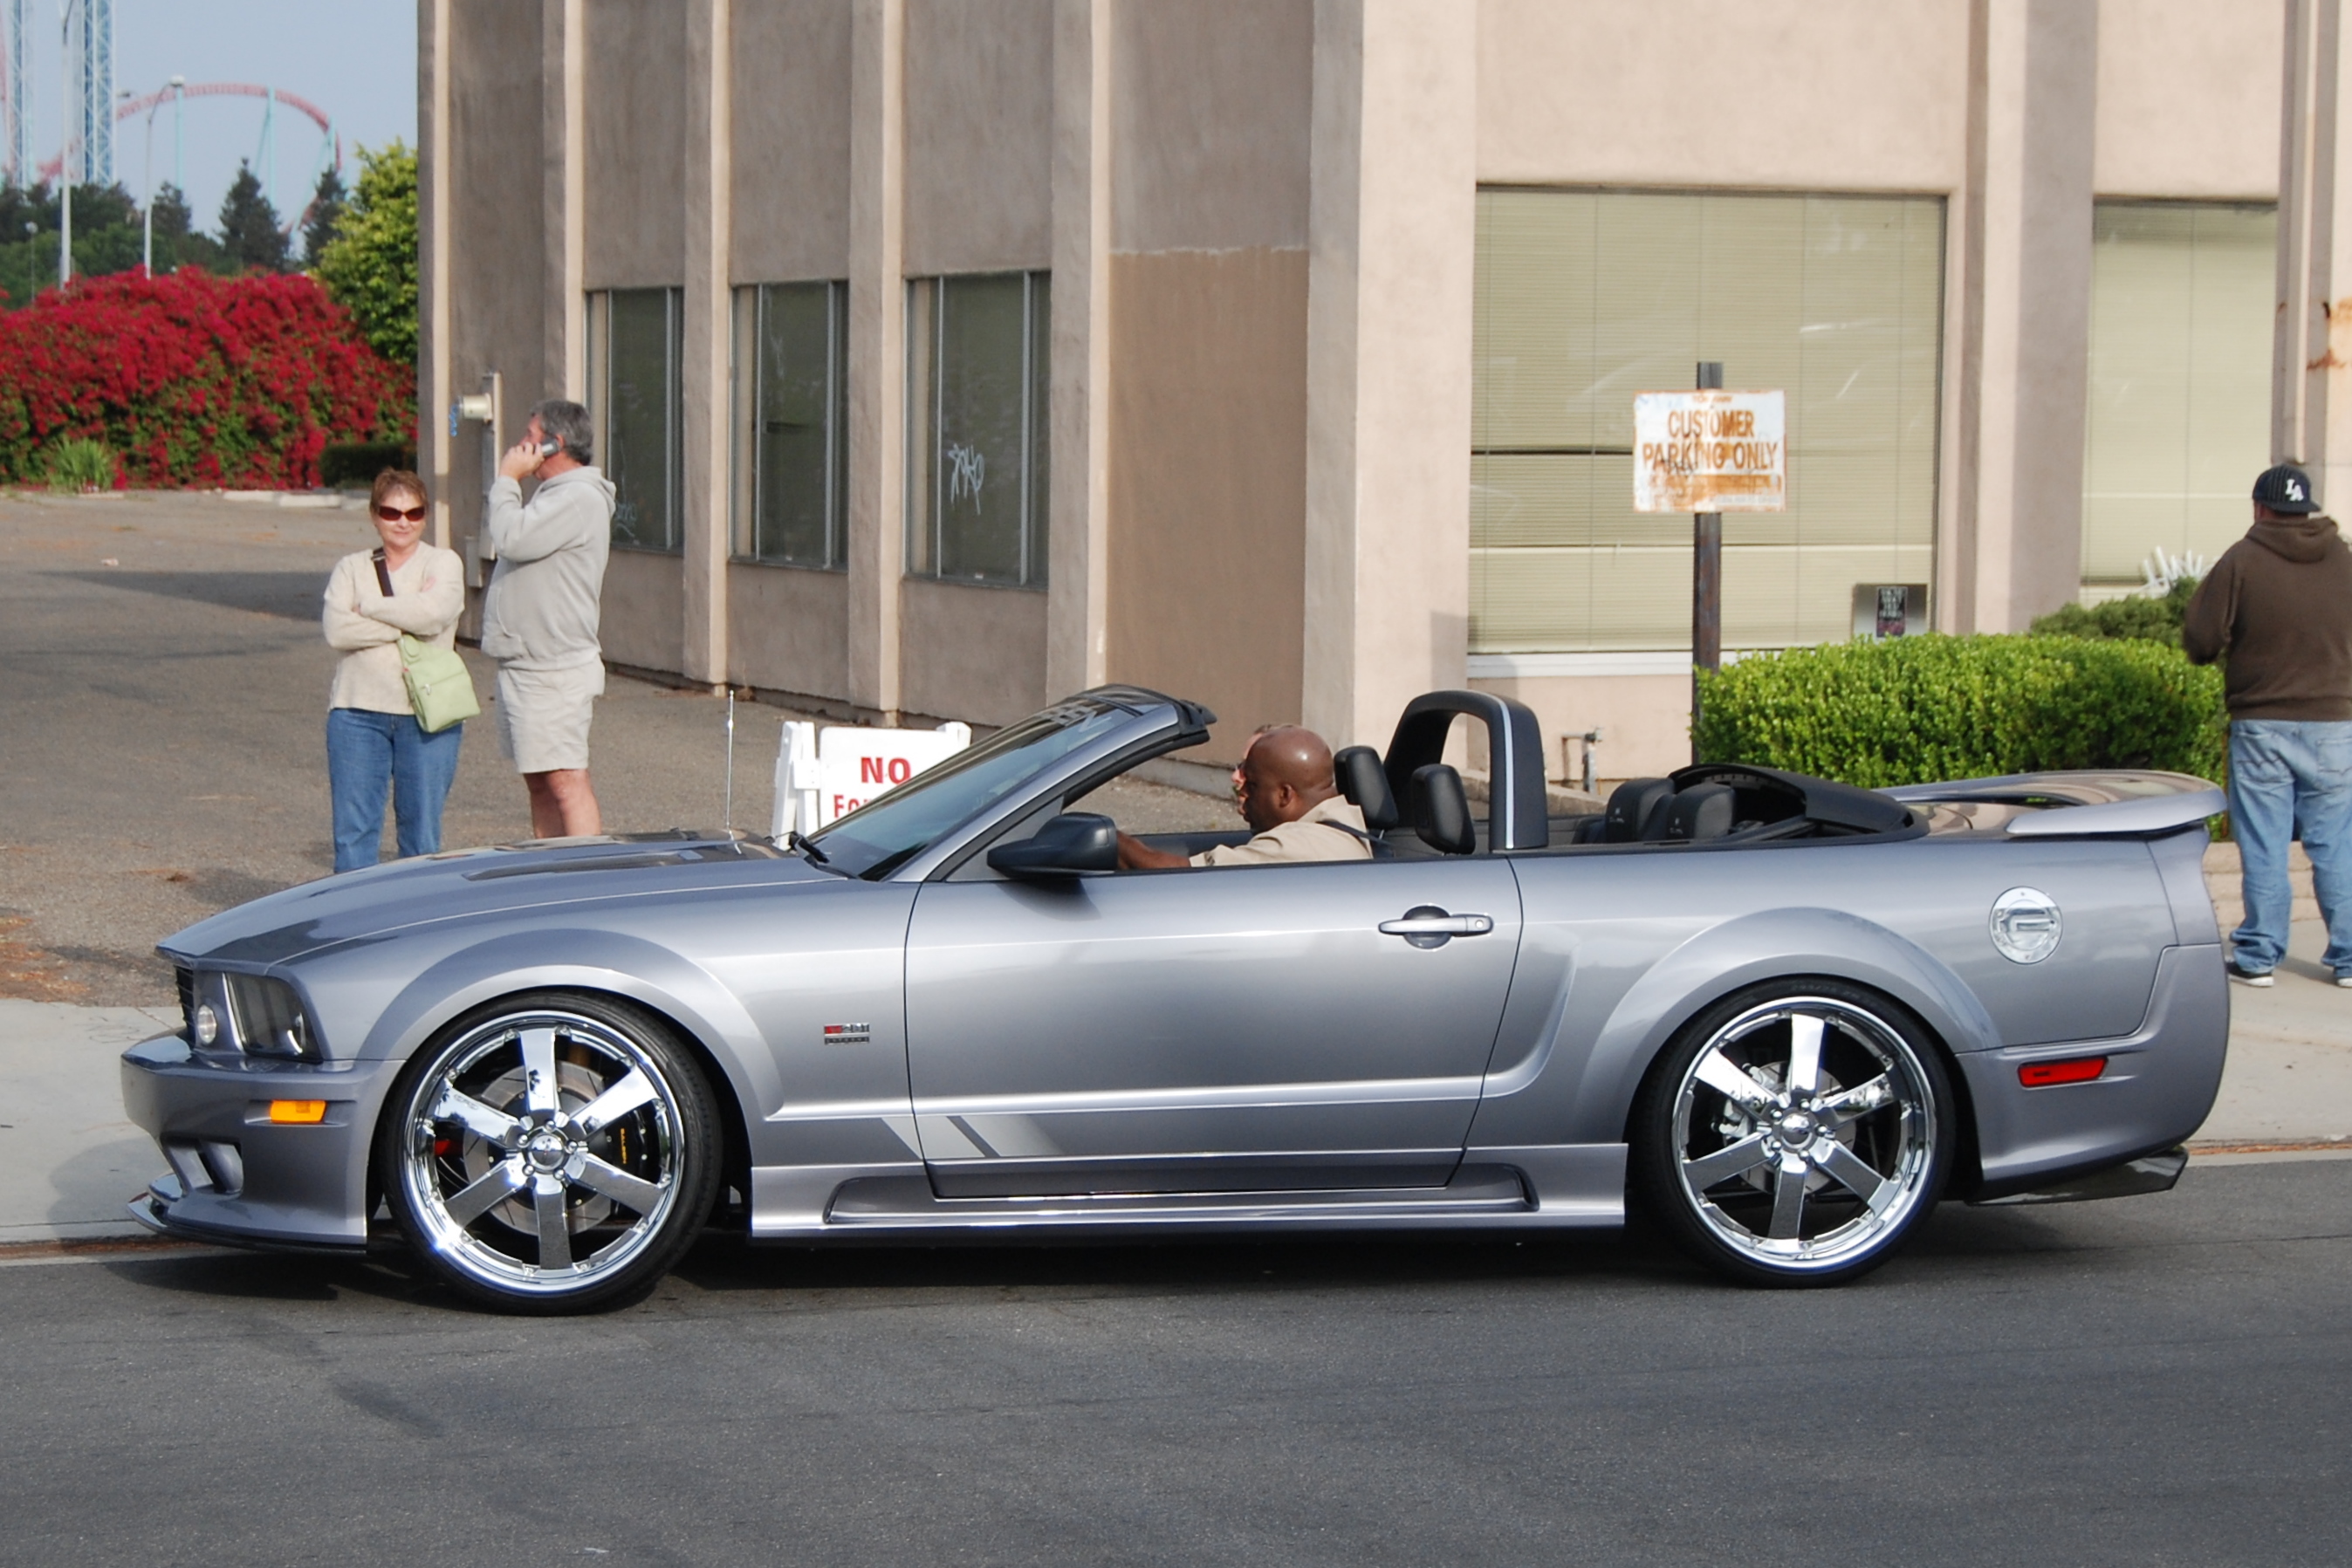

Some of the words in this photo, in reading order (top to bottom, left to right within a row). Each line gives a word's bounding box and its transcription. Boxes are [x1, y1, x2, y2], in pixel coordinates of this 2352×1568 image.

[1668, 409, 1754, 438] CUSTOMER
[1642, 442, 1725, 471] PARKING
[1732, 442, 1778, 469] ONLY
[2286, 478, 2304, 502] LA
[861, 757, 911, 784] NO
